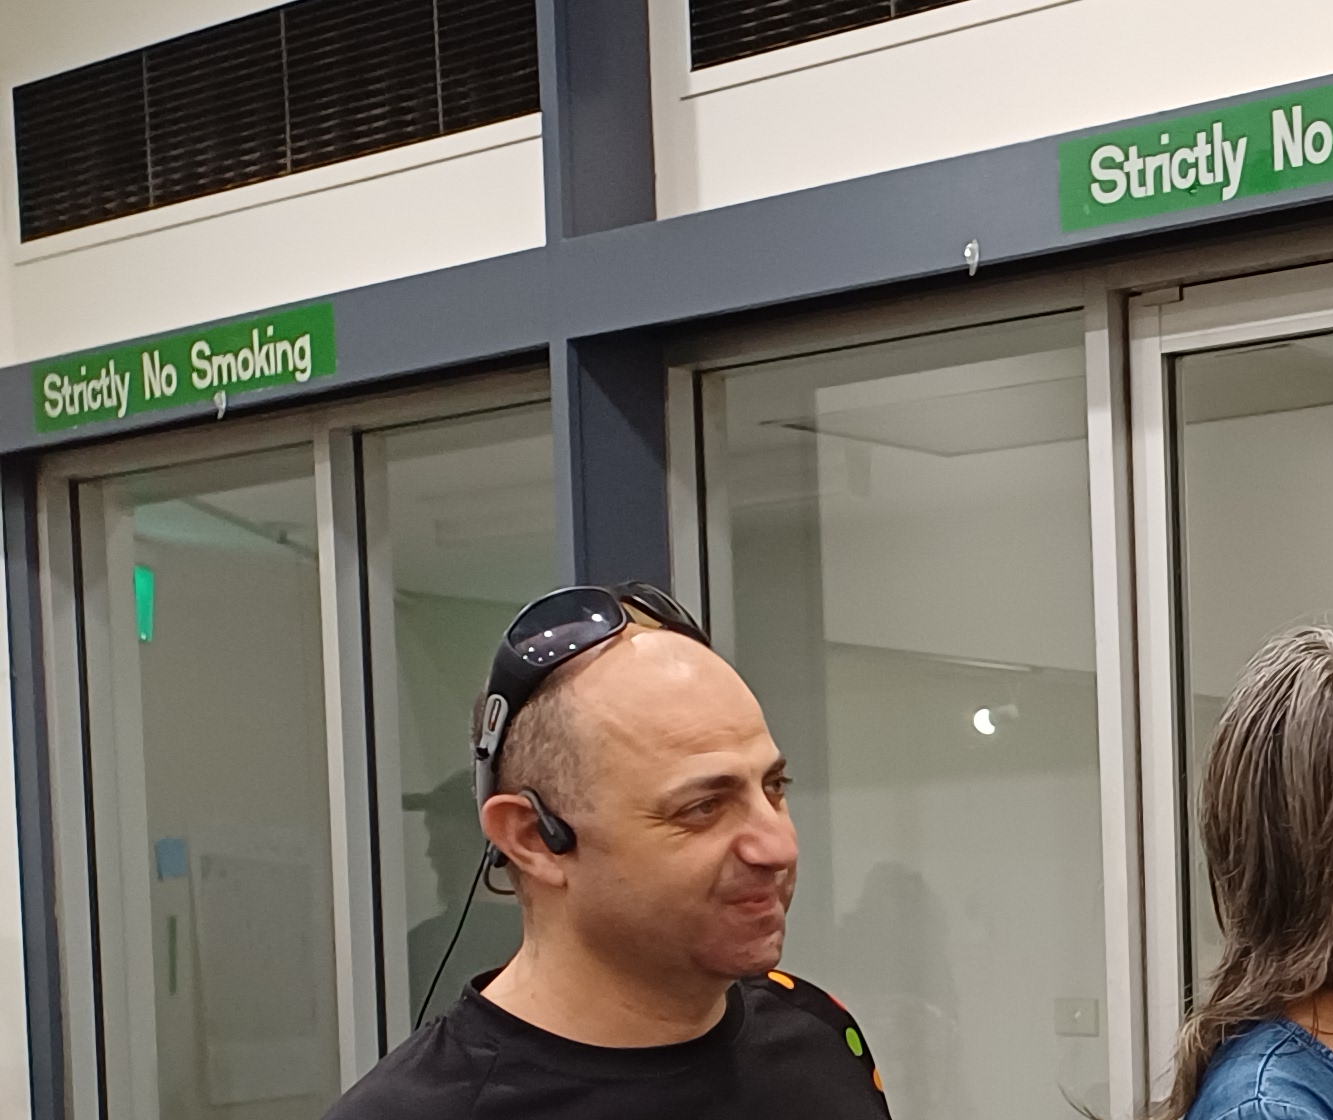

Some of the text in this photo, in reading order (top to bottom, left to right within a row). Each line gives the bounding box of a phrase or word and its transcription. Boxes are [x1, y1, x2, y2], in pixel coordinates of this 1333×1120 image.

[1089, 121, 1248, 204] Strictly
[1272, 105, 1333, 171] No
[43, 325, 312, 418] Strictly No Smoking
